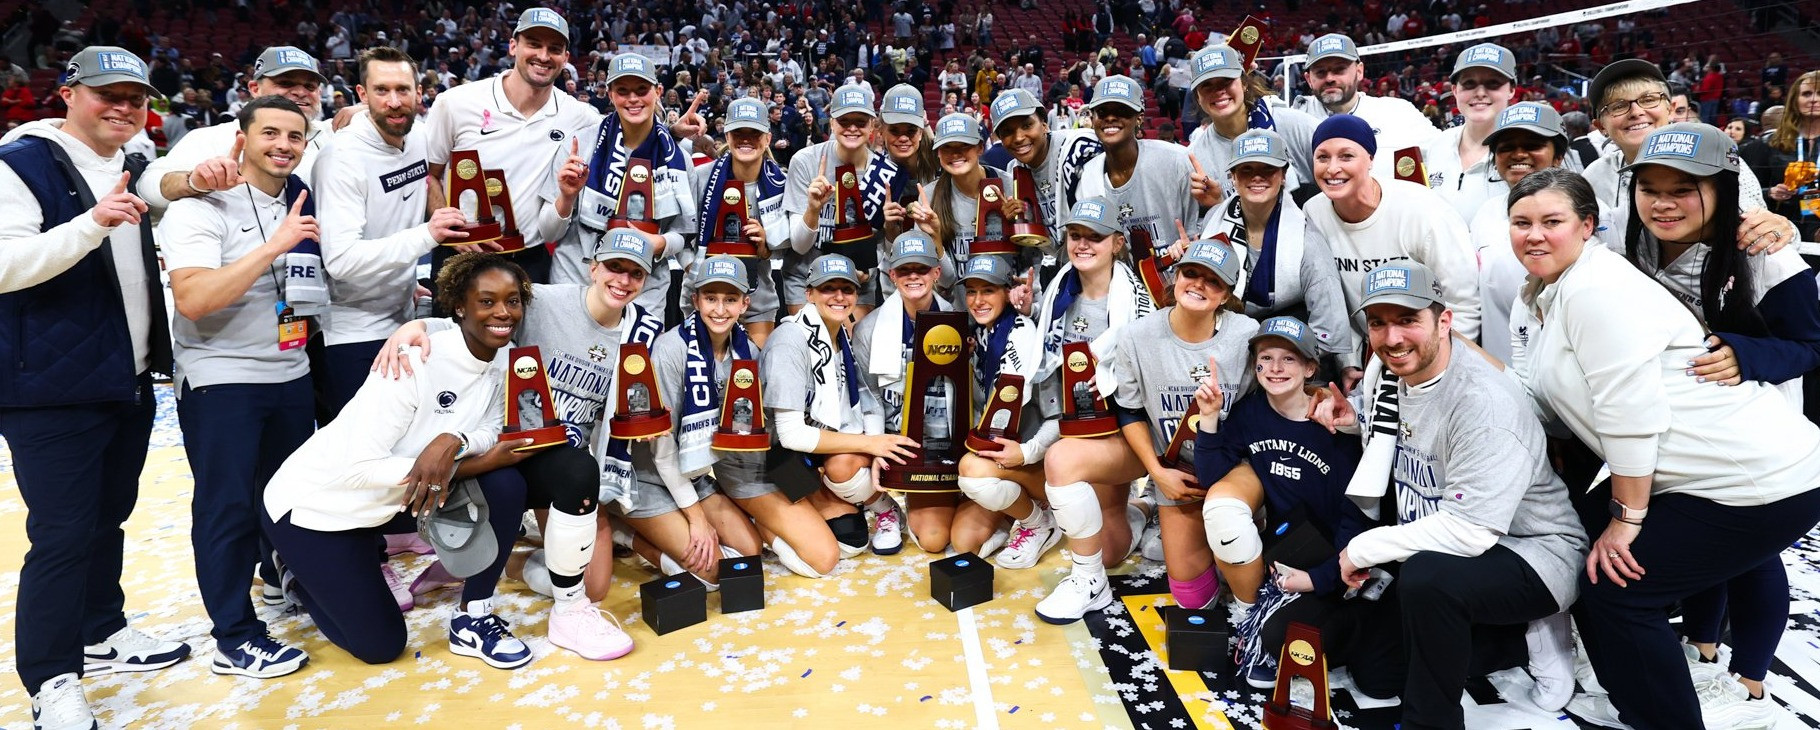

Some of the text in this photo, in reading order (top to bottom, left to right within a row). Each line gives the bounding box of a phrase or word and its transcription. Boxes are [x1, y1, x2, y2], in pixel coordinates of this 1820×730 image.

[1472, 53, 1499, 62] CHAMPIONS
[1474, 47, 1500, 56] NATIONAL
[112, 54, 142, 70] NATIONAL
[111, 61, 145, 79] CHAMPIONS
[1506, 112, 1536, 122] CHAMPIONS
[1509, 106, 1535, 115] NATIONAL
[1659, 133, 1695, 145] NATIONAL
[1655, 142, 1693, 156] CHAMPIONS
[387, 165, 427, 188] PENN STATE
[704, 167, 720, 209] NITTANY
[699, 210, 708, 243] LIONS
[1197, 249, 1224, 265] CHAMPIONS
[1202, 244, 1227, 257] NATIONAL
[1377, 269, 1406, 280] NATIONAL
[1374, 277, 1406, 289] CHAMPIONS
[1274, 325, 1299, 338] CHAMPIONS
[1276, 320, 1301, 332] NATIONAL
[926, 344, 960, 356] NCAA
[682, 419, 710, 433] WOMEN'S
[1297, 445, 1331, 476] LIONS
[1270, 461, 1302, 481] 1855
[911, 474, 940, 482] NATIONAL
[1291, 651, 1314, 662] NCAA
